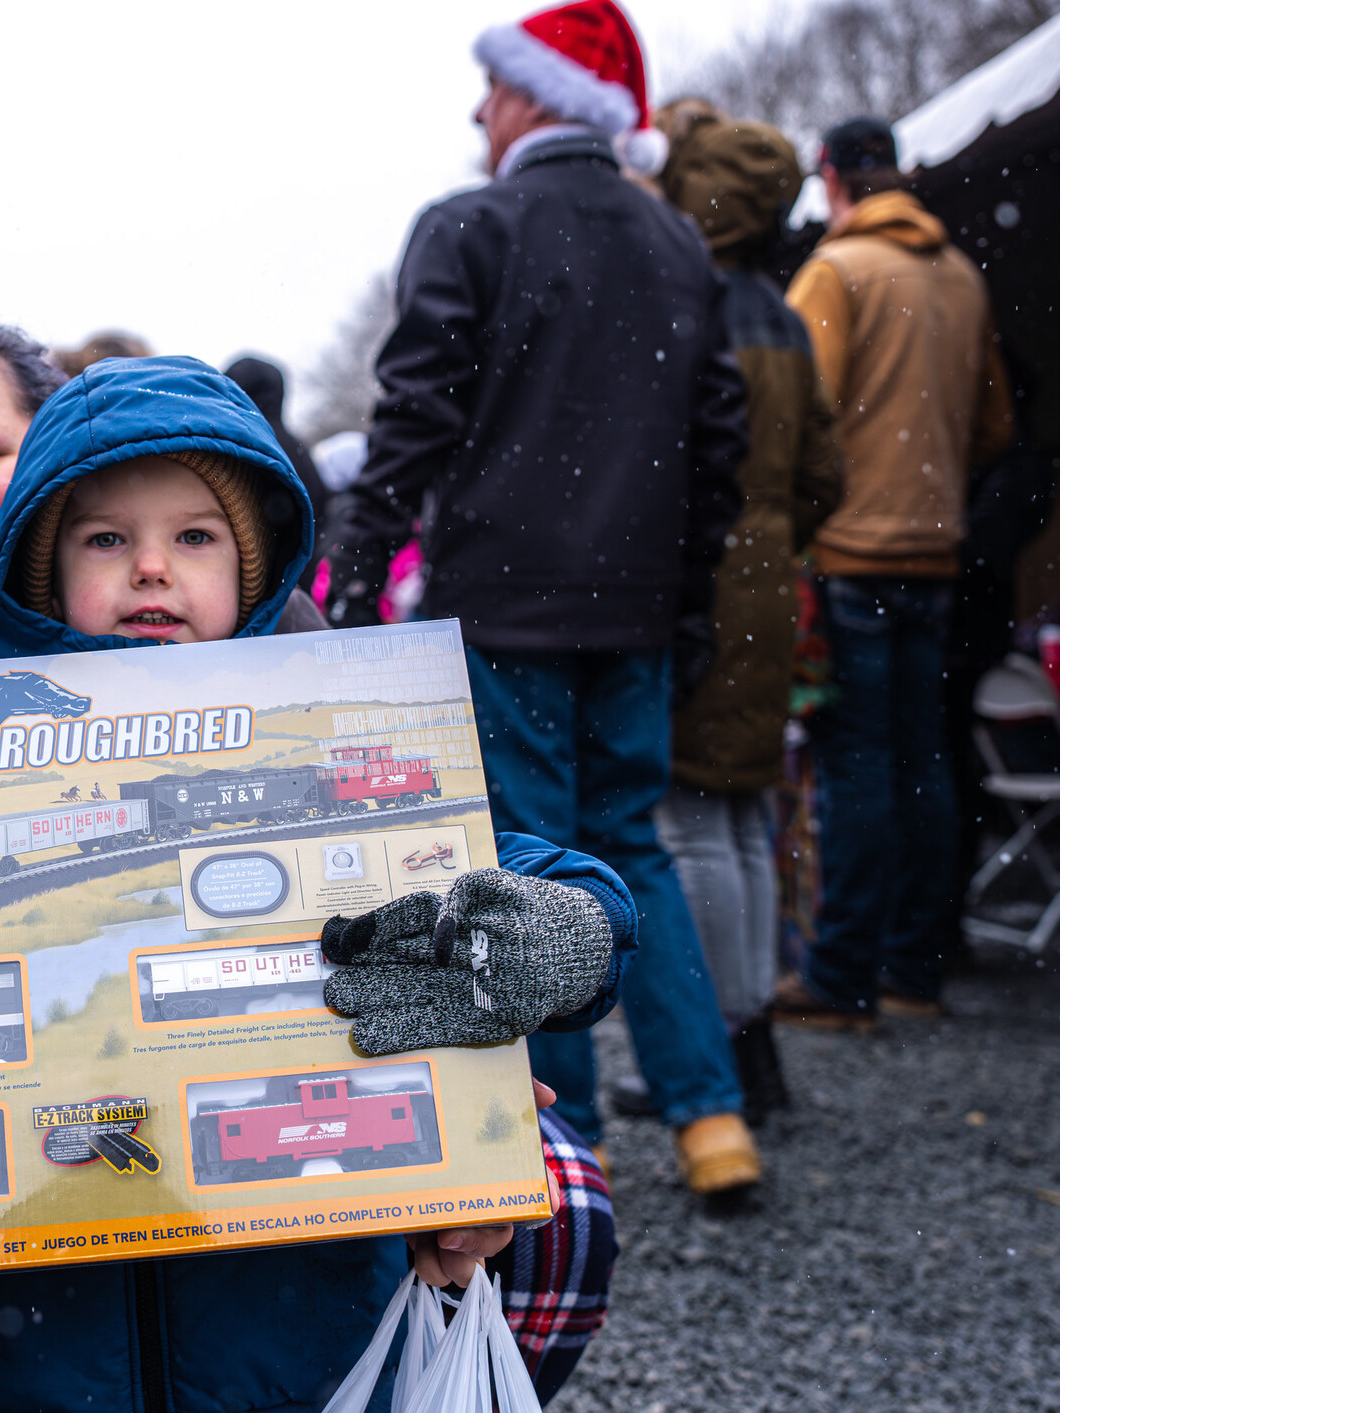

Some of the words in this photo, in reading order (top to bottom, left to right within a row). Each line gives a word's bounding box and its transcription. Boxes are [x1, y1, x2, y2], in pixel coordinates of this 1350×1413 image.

[220, 790, 232, 804] N
[237, 789, 249, 802] &
[252, 788, 265, 801] W
[32, 809, 111, 835] SOUTHERN
[167, 1032, 185, 1040] Three
[186, 1031, 206, 1039] Finely
[207, 1028, 234, 1036] Detailed
[236, 1026, 259, 1035] Freight
[276, 1021, 305, 1031] including
[306, 1019, 333, 1028] Hopper,
[148, 1043, 177, 1053] furgones
[218, 1037, 247, 1047] exquisito
[248, 1035, 272, 1043] detalle,
[273, 1031, 308, 1042] incluyendo
[12, 1081, 40, 1089] enciende
[34, 1098, 145, 1113] BACHMANN
[37, 1112, 54, 1125] E-Z
[56, 1109, 94, 1124] TRACK
[315, 1121, 347, 1134] NS
[277, 1136, 308, 1144] NORFOLK
[309, 1132, 346, 1140] SOUTHERN
[41, 1235, 86, 1250] JUEGO
[90, 1233, 108, 1245] DE
[112, 1229, 148, 1243] TREN
[152, 1222, 223, 1239] ELECTRICO
[227, 1220, 245, 1233] EN
[249, 1215, 301, 1230] ESCALA
[304, 1213, 325, 1225] HO
[328, 1206, 402, 1223] COMPLETO
[405, 1204, 415, 1216] Y
[418, 1201, 455, 1215] LISTO
[458, 1197, 495, 1211] PARA
[497, 1192, 546, 1207] ANDAR
[3, 1240, 27, 1253] SET
